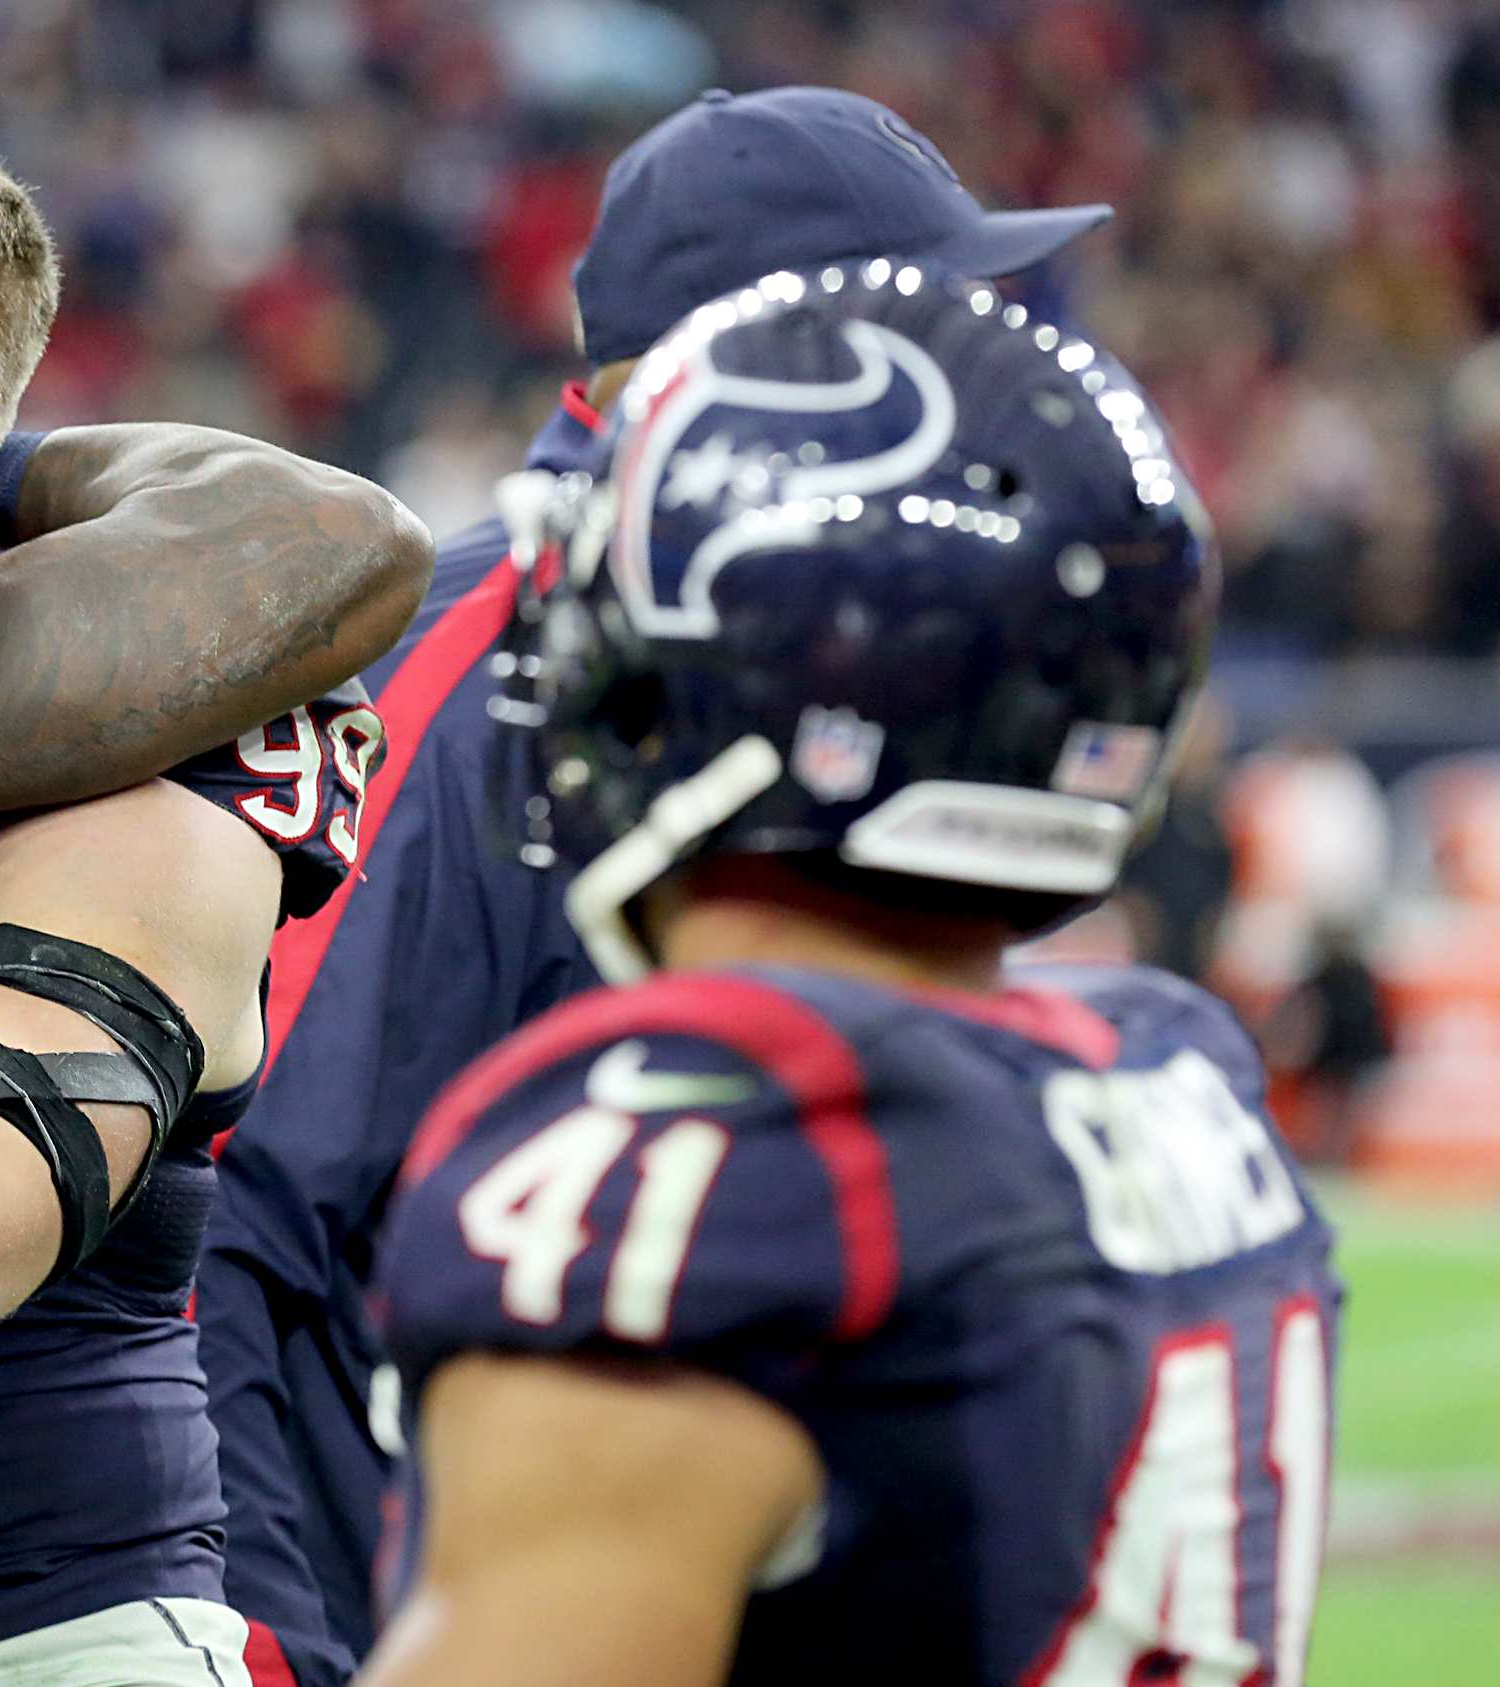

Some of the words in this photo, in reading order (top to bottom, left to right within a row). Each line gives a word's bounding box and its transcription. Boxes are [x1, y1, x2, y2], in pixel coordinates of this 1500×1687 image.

[235, 703, 386, 868] 99
[458, 1103, 730, 1344] 41
[1014, 1294, 1330, 1687] 41
